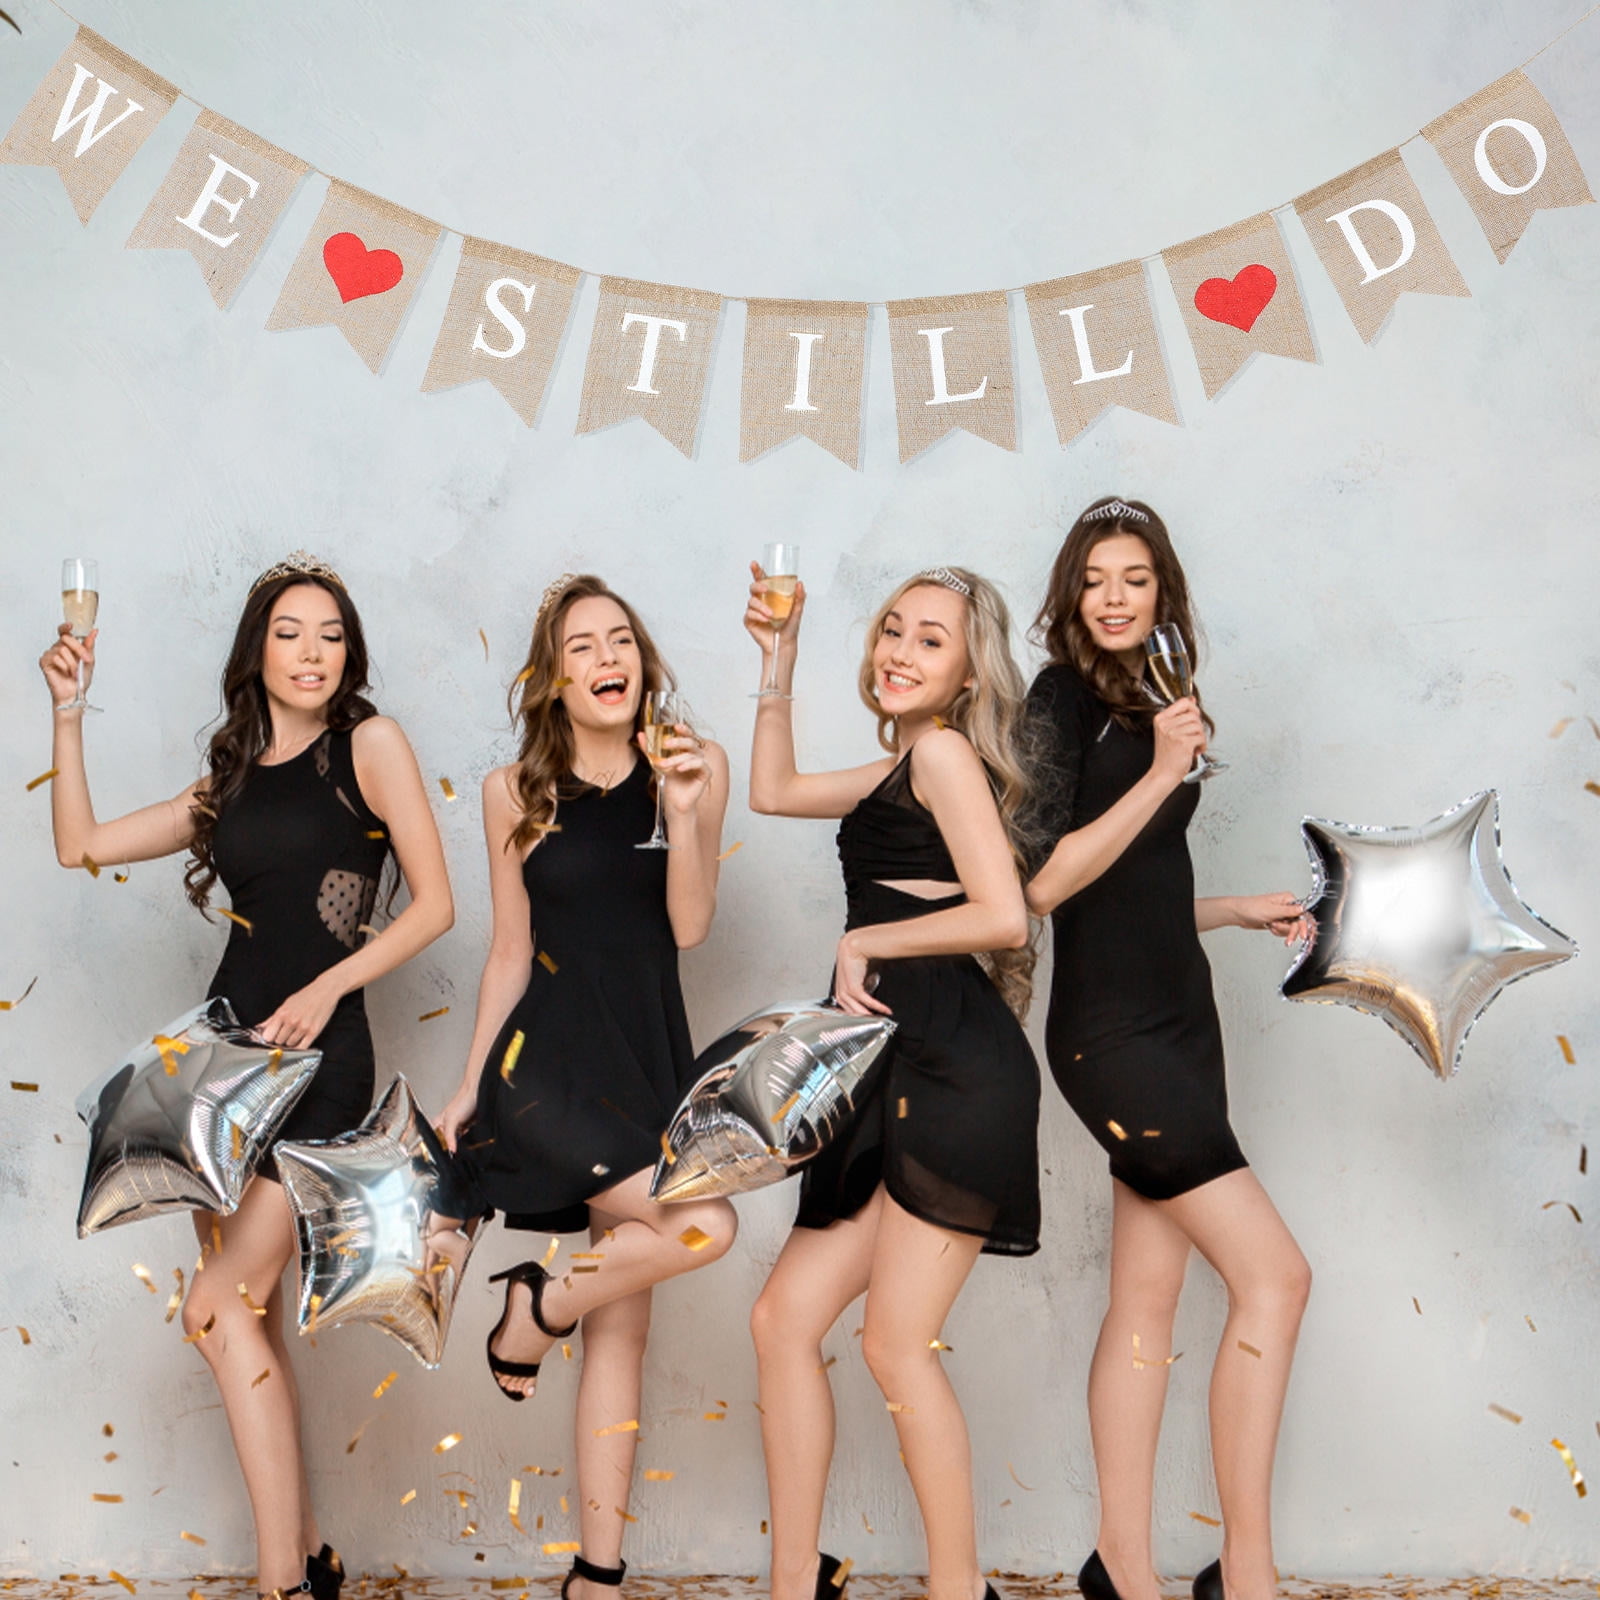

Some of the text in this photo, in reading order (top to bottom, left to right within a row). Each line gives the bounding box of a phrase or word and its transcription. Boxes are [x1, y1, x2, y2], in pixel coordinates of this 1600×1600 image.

[50, 63, 1548, 413] WE STILL DO
